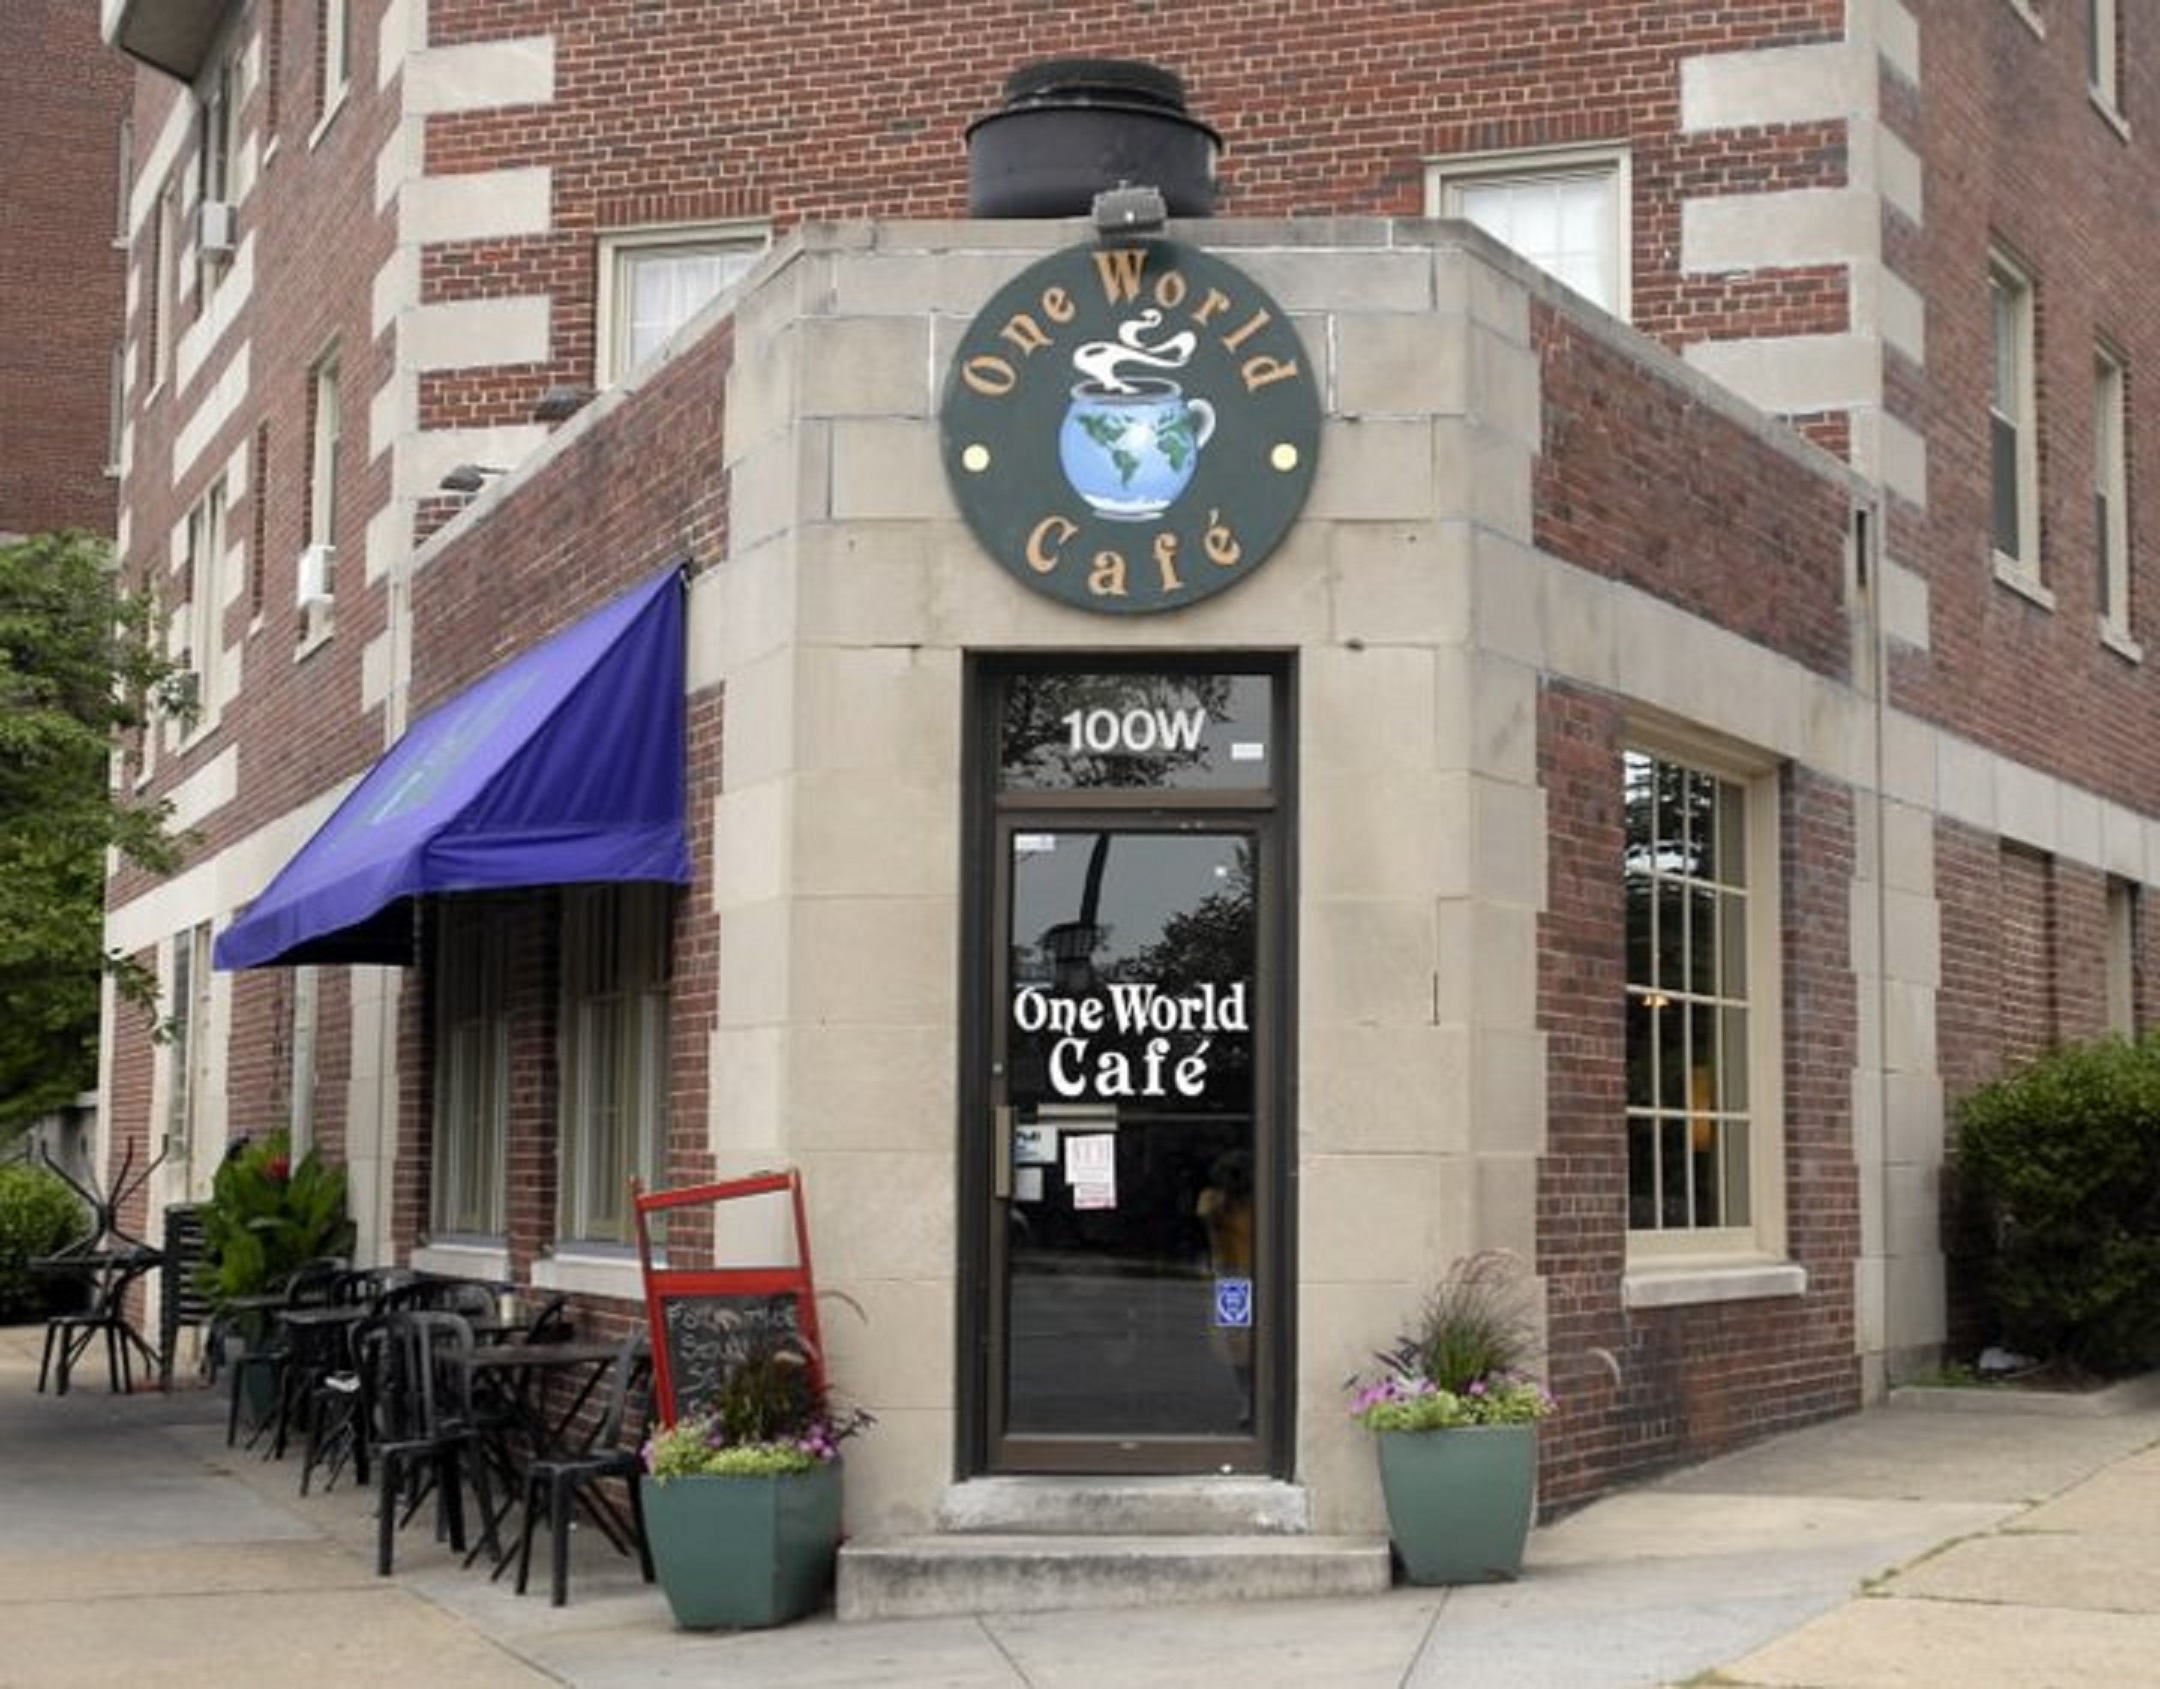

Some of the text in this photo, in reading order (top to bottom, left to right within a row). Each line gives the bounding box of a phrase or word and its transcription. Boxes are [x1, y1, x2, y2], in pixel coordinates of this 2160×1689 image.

[962, 248, 1298, 397] One World
[1025, 508, 1241, 597] Café
[1061, 708, 1206, 752] 100W
[1014, 982, 1249, 1036] One World
[1049, 1036, 1212, 1097] Café
